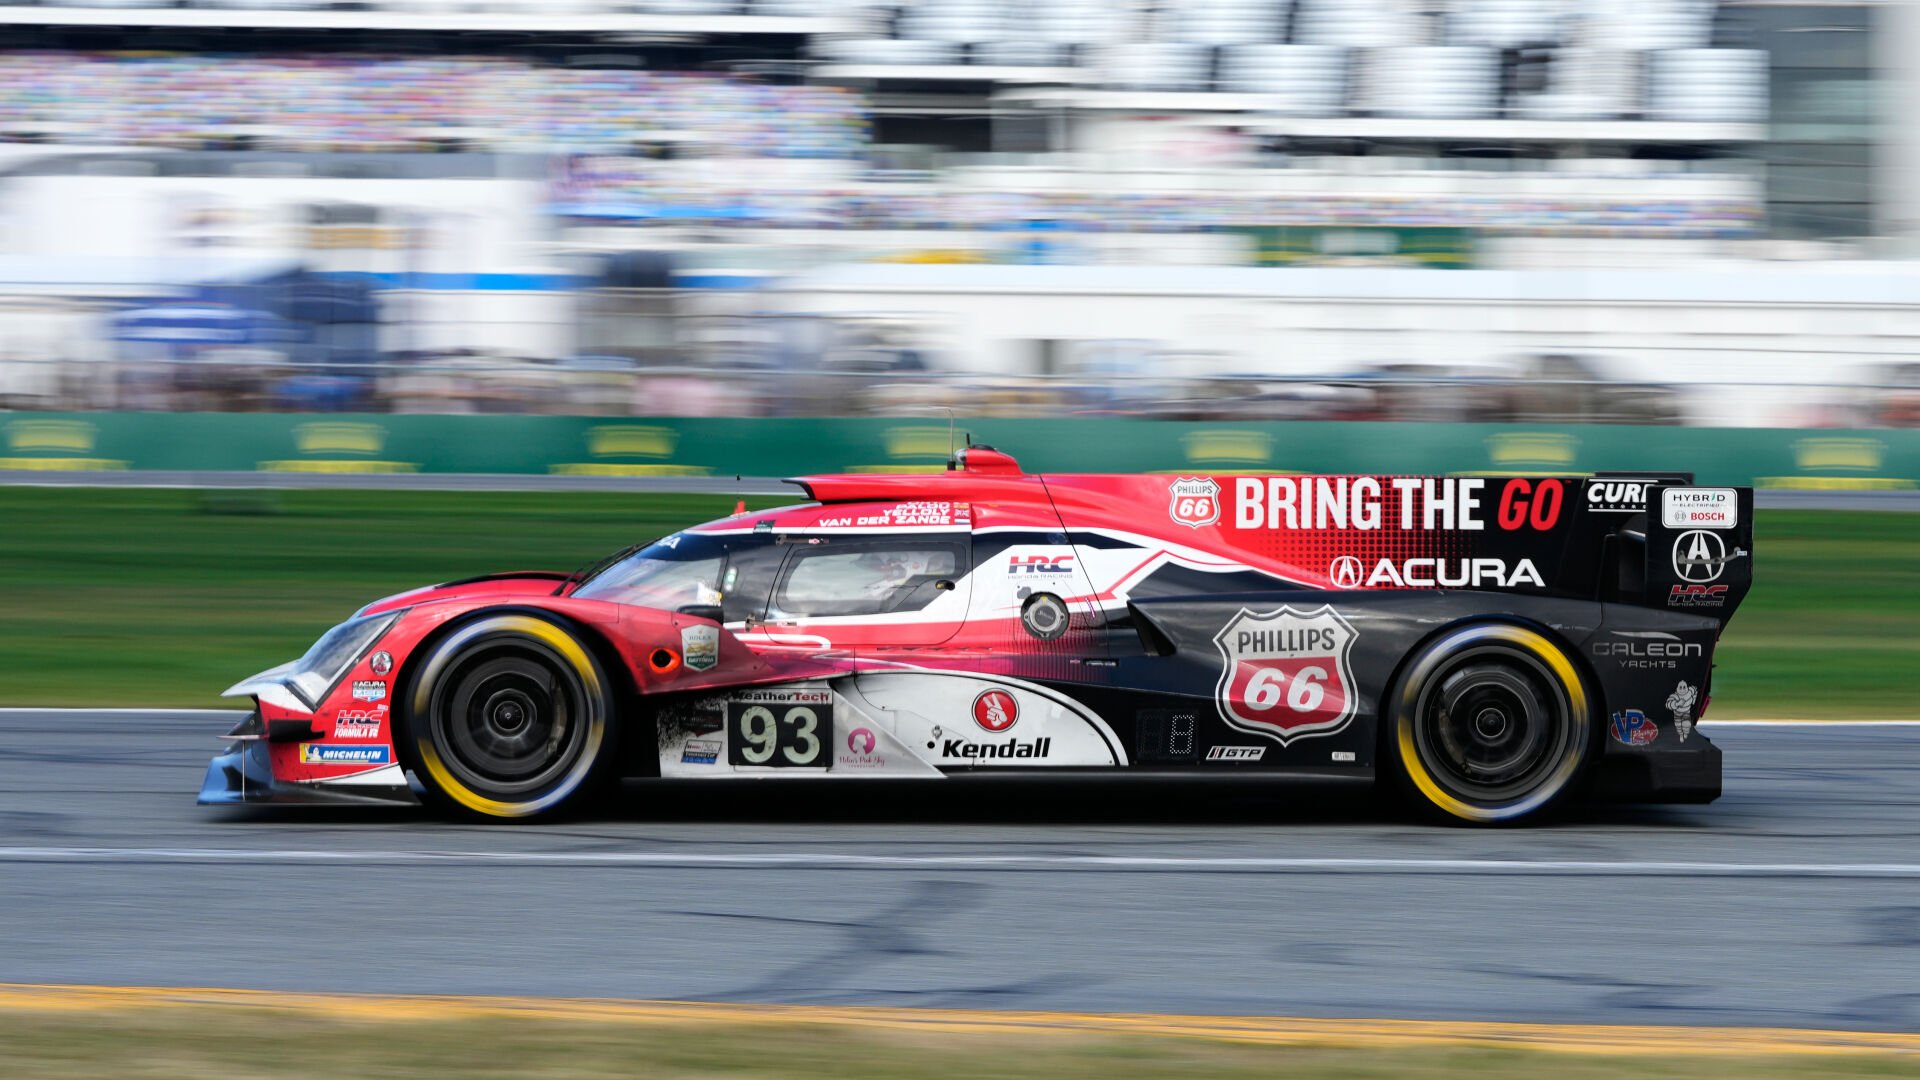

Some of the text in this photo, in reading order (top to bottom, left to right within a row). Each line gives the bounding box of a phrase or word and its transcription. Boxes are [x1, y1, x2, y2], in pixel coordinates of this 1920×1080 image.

[1177, 485, 1213, 496] PHILLIPS
[1179, 498, 1210, 516] 66
[1234, 477, 1564, 531] BRING THE GO
[819, 515, 950, 527] VAN DER ZANDE
[1691, 512, 1725, 521] BOSCH
[1008, 555, 1074, 574] HRC
[1364, 558, 1547, 587] ACURA
[1668, 584, 1729, 603] HRC
[1237, 627, 1336, 654] PHILLIPS
[1592, 642, 1702, 657] GALEON
[1619, 660, 1677, 668] YACHTS
[1243, 665, 1329, 713] 66
[739, 705, 821, 765] 93
[1612, 708, 1646, 745] VP
[322, 750, 382, 760] MICHELIN
[942, 737, 1051, 759] Kendall
[1225, 748, 1262, 758] GTP
